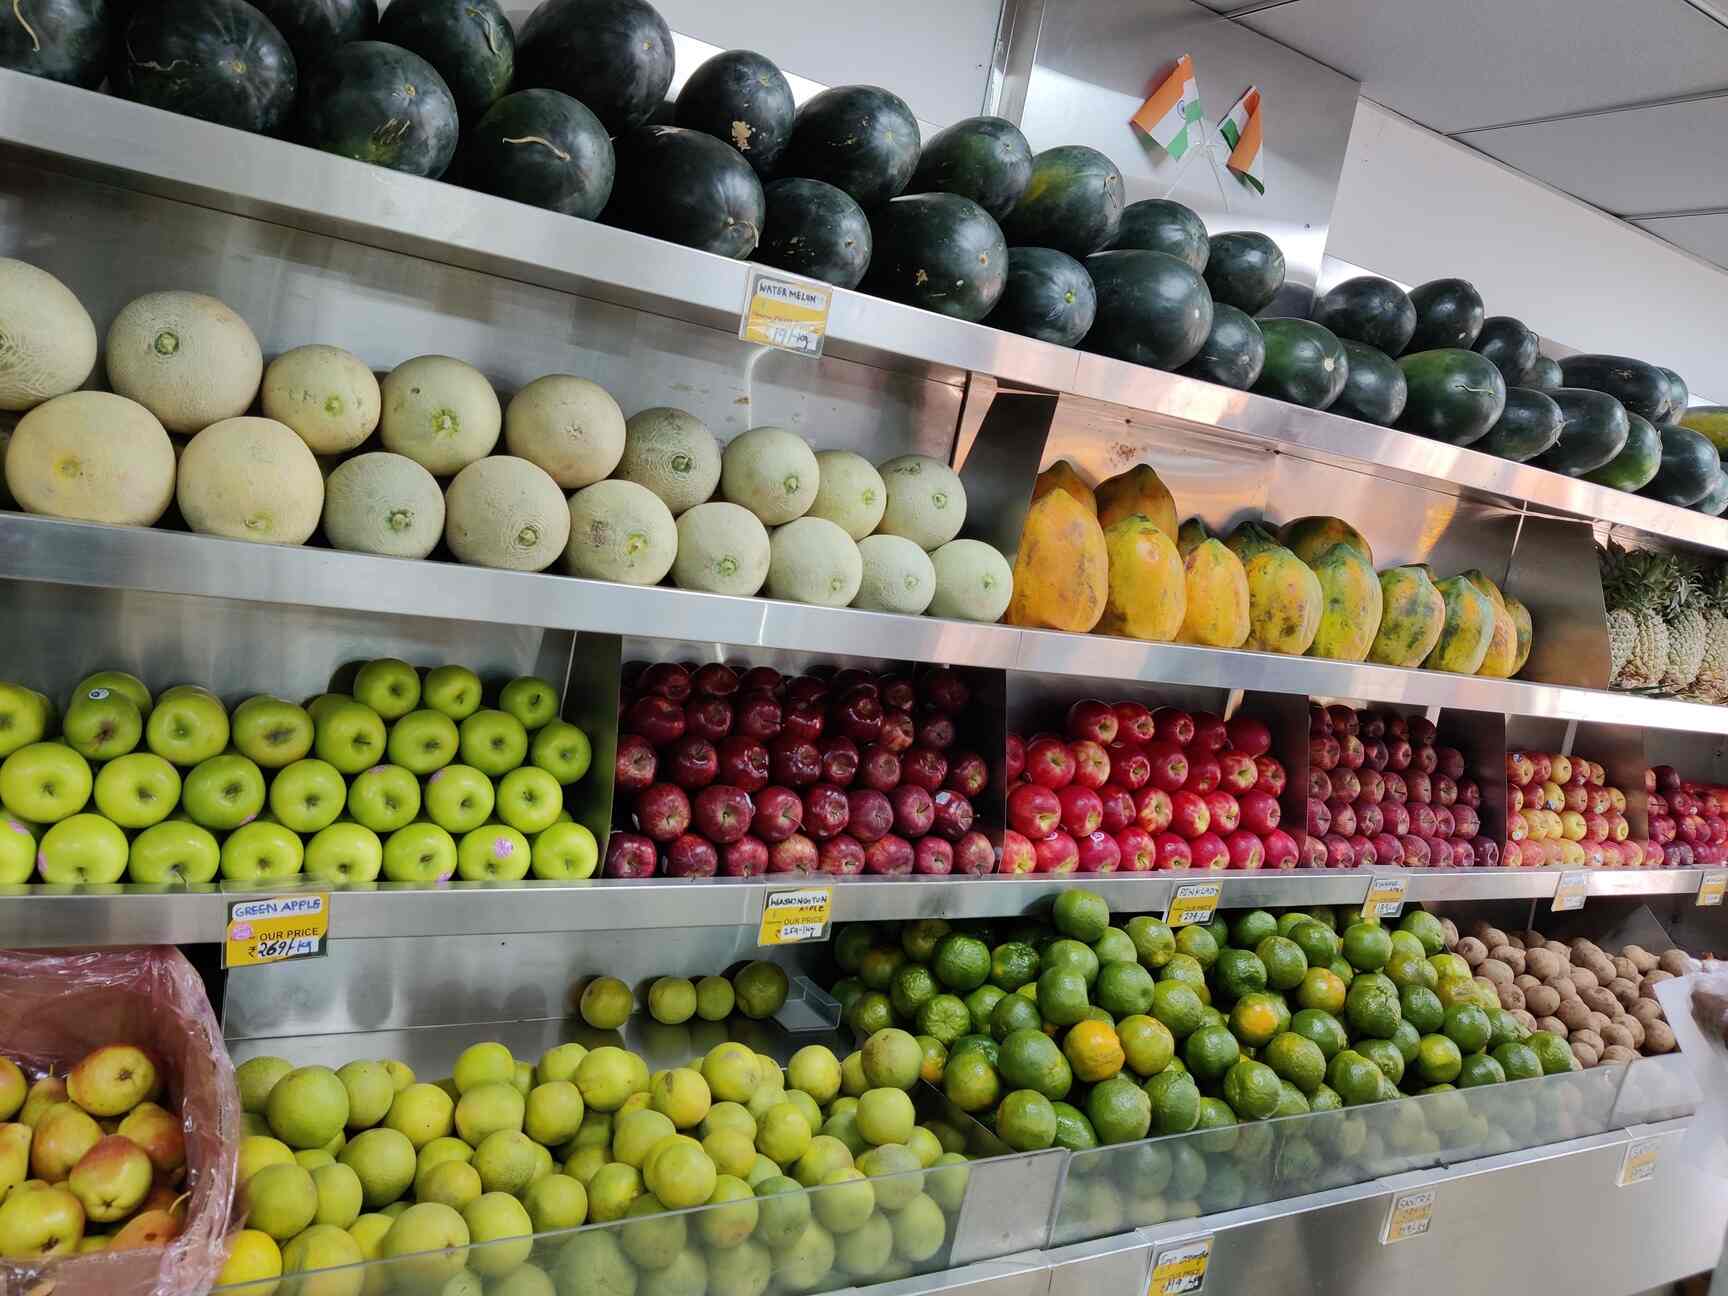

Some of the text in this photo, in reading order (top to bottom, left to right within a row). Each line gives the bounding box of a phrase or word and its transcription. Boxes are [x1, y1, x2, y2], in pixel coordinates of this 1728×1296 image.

[234, 899, 320, 917] GREEN APPLE
[260, 927, 319, 941] OUR PRICE
